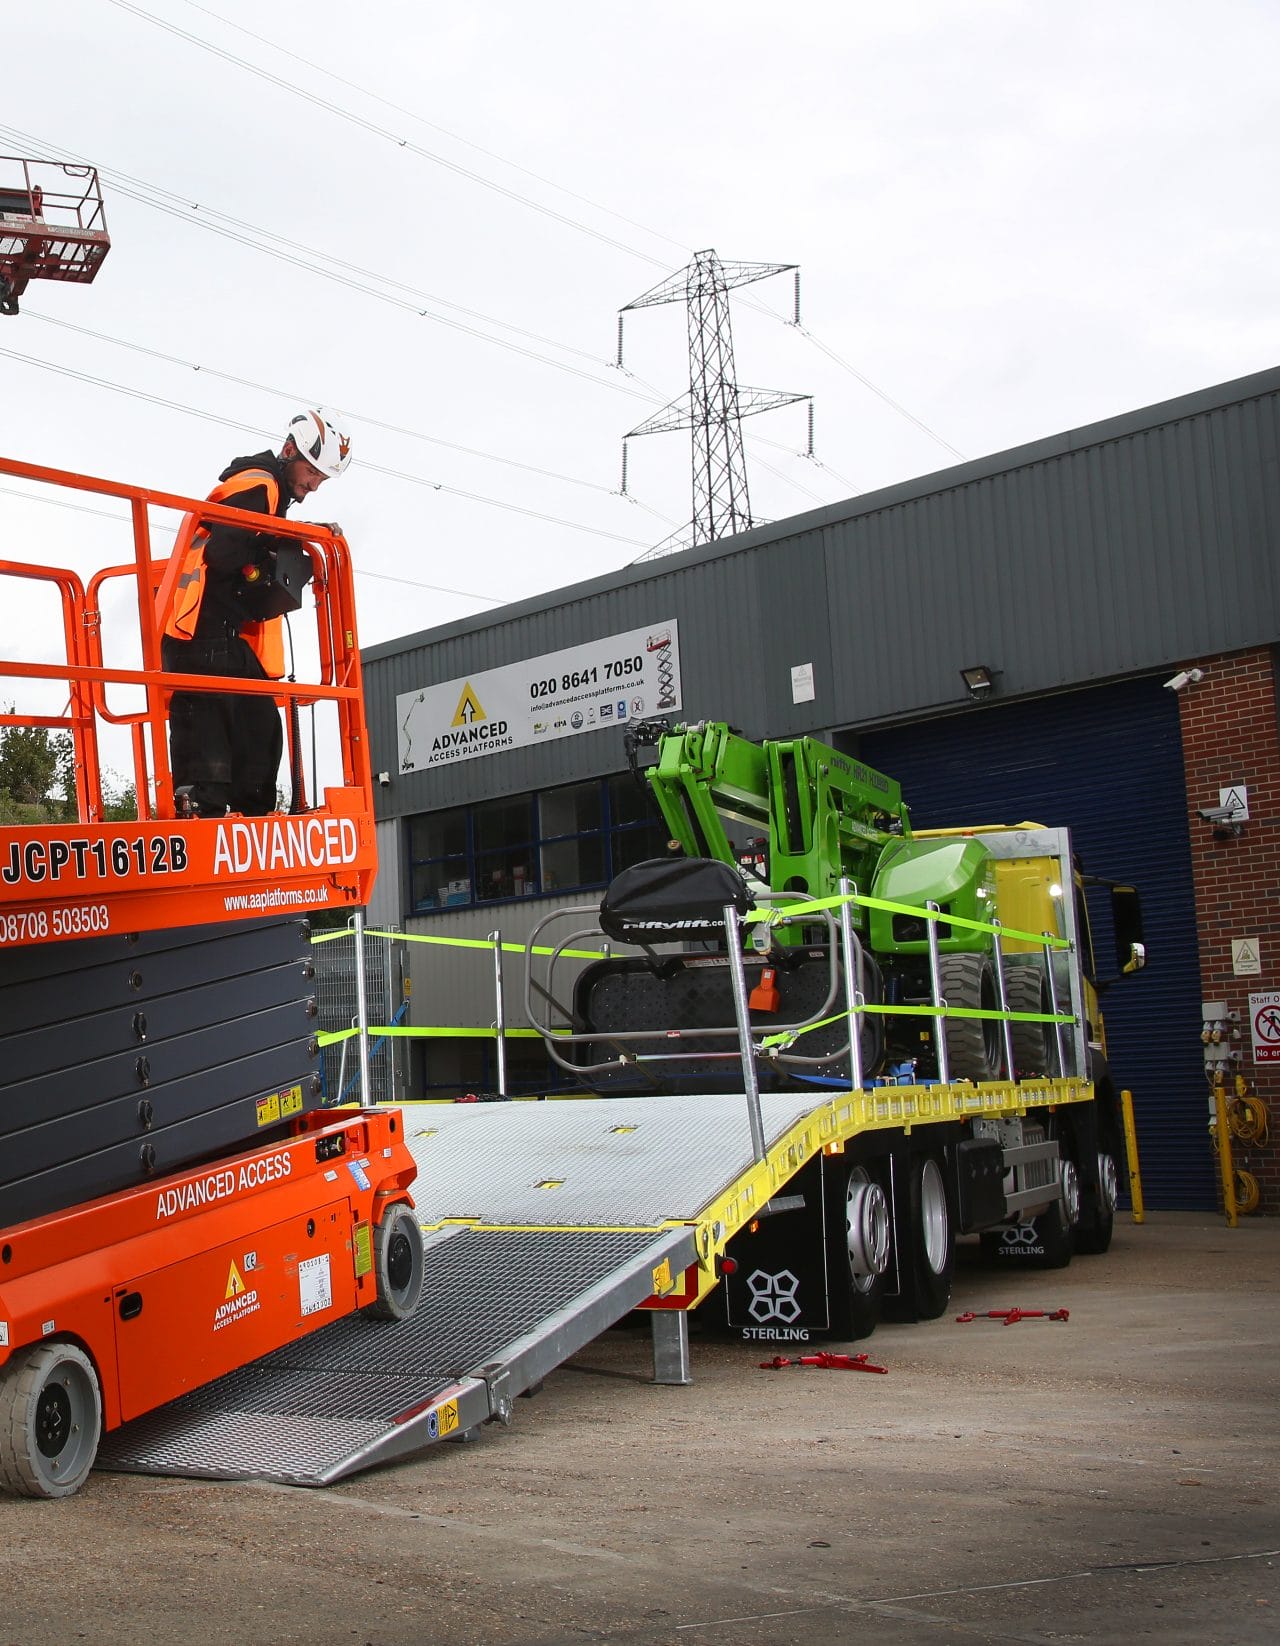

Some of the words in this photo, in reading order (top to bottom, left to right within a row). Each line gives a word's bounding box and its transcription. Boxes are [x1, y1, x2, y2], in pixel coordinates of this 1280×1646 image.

[530, 678, 557, 698] 020
[562, 667, 598, 691] 8641
[604, 656, 643, 680] 7050
[429, 749, 460, 763] ACCESS
[463, 736, 513, 755] PLATFORMS
[432, 721, 507, 751] ADVANCED
[1, 835, 189, 884] JCPT1612B
[213, 818, 357, 875] ADVANCED
[224, 884, 329, 912] www.aaplatforms.co.uk
[53, 905, 110, 936] 503503
[1251, 996, 1270, 1004] Staff
[1256, 1049, 1268, 1057] No
[156, 1170, 235, 1220] ADVANCED
[238, 1152, 292, 1191] ACCESS
[999, 1246, 1045, 1255] STERLING
[213, 1316, 233, 1331] ACCESS
[233, 1303, 261, 1322] PLATFORMS
[215, 1290, 257, 1321] ADVANCED
[743, 1327, 809, 1340] STERLING
